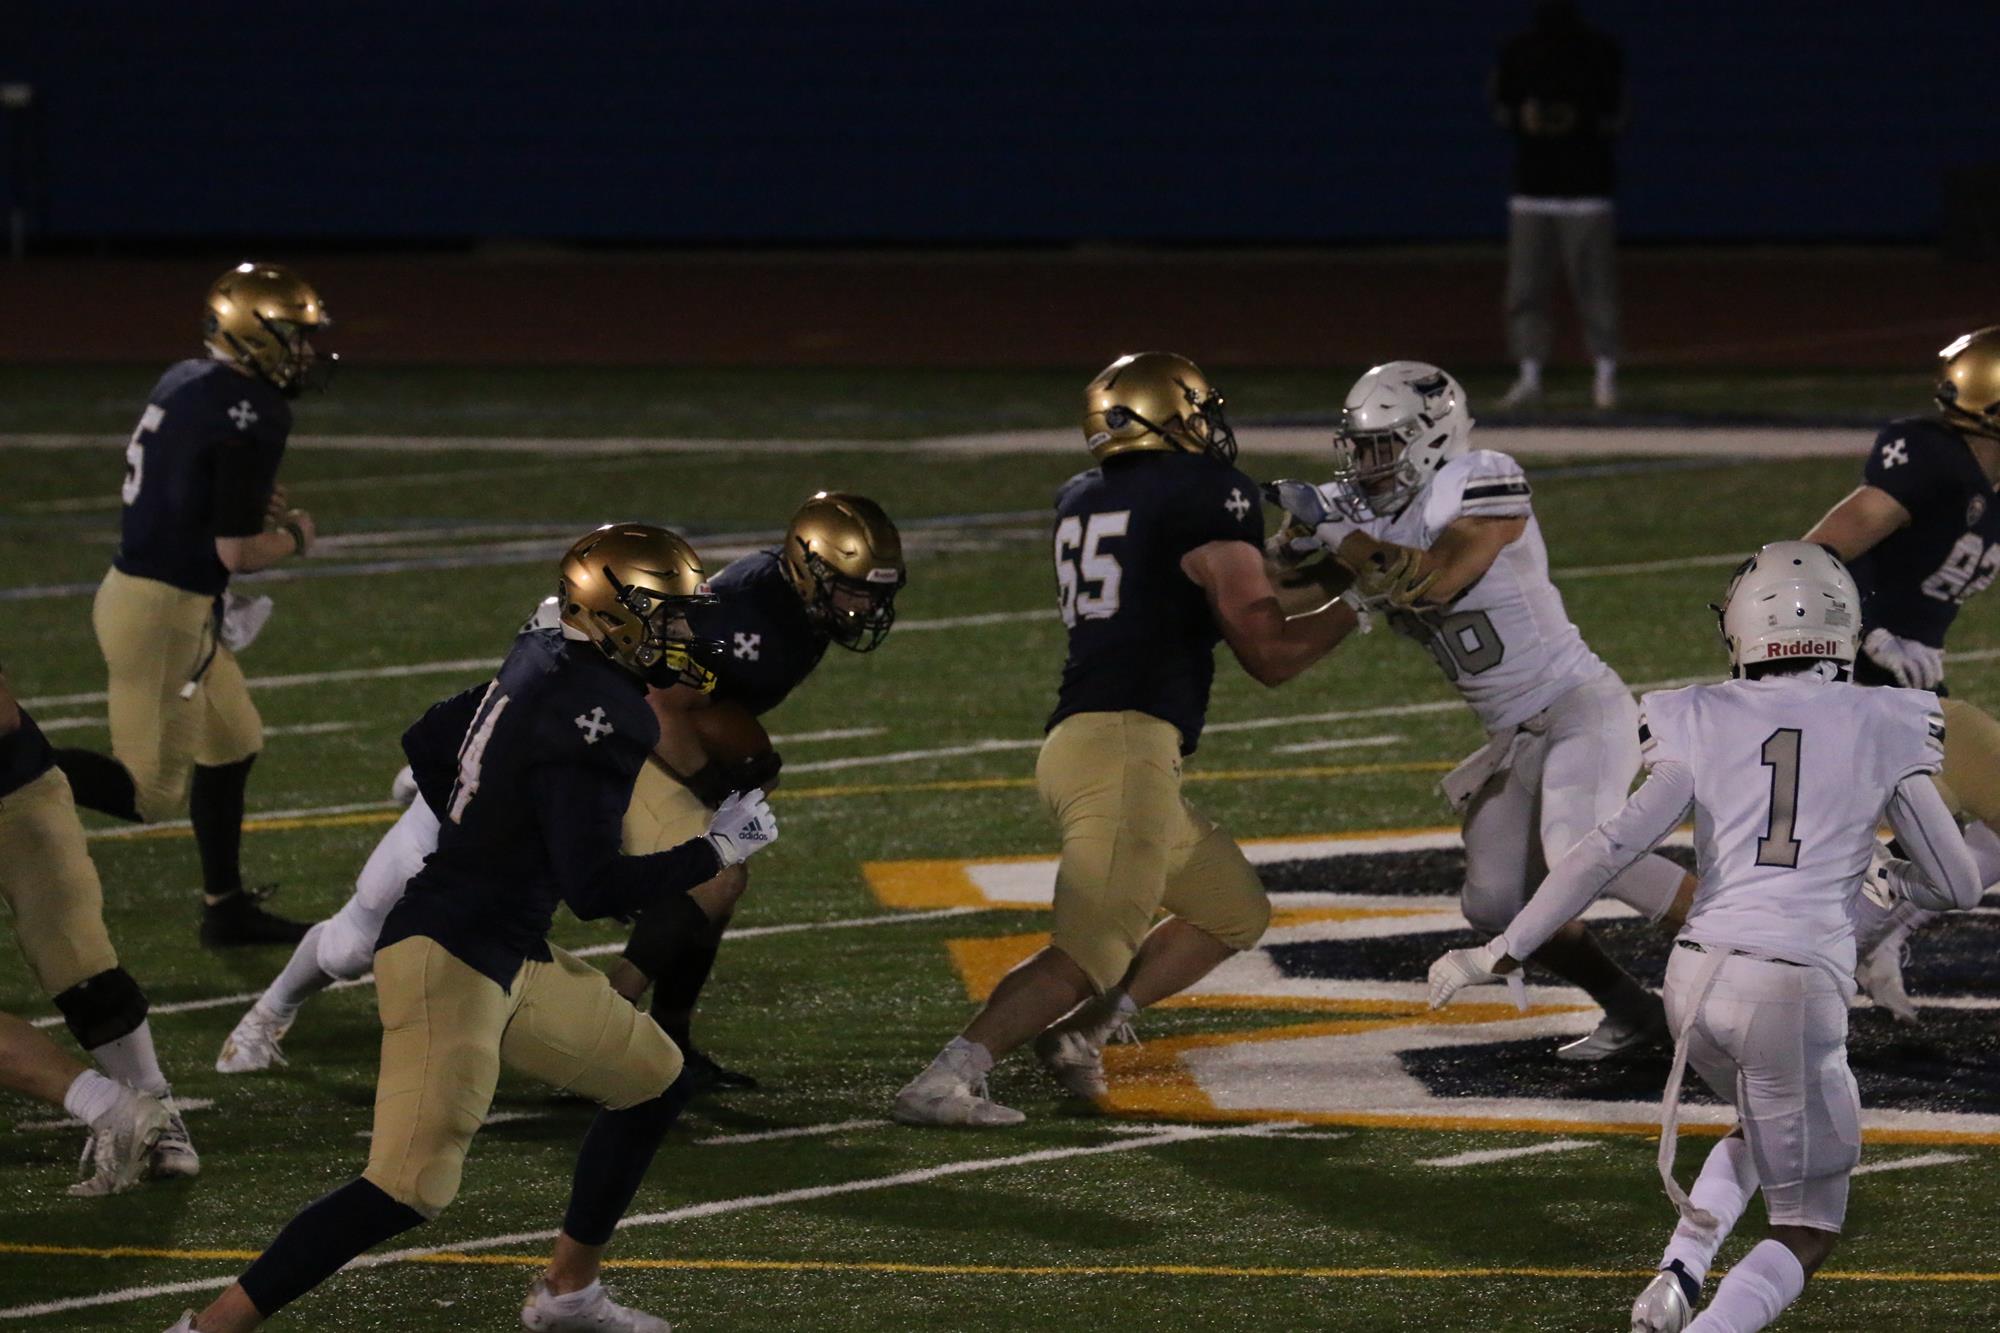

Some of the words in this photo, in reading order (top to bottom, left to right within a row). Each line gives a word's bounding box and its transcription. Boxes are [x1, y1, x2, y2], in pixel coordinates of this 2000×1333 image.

[122, 403, 167, 506] 5
[1054, 510, 1132, 629] 65
[1767, 640, 1837, 657] Riddell
[739, 831, 768, 841] adidas
[1754, 727, 1802, 869] 1
